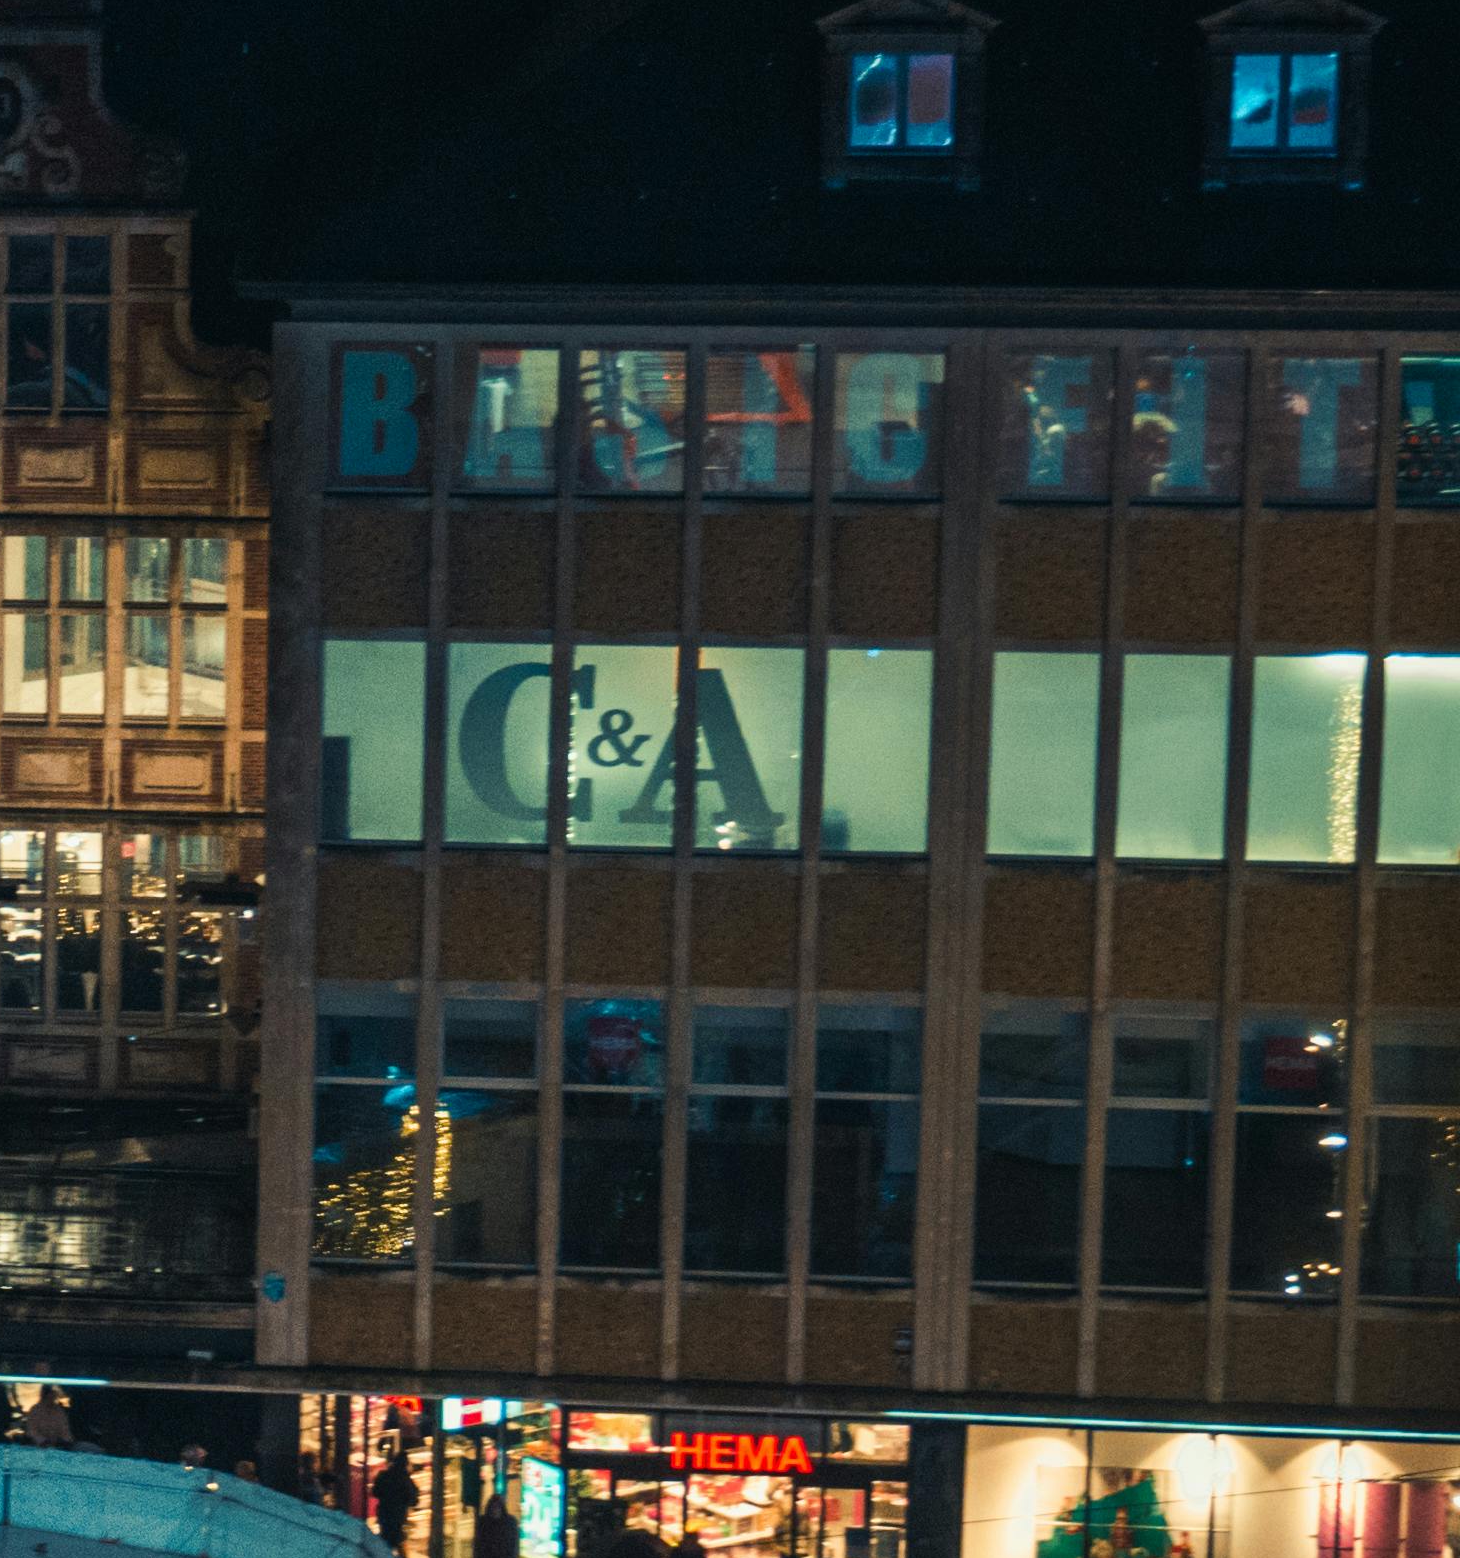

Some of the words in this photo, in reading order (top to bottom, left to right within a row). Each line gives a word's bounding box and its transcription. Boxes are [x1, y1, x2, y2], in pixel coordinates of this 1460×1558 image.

[1027, 355, 1361, 489] FIT
[459, 662, 785, 825] C&A
[670, 1431, 814, 1474] HEMA
